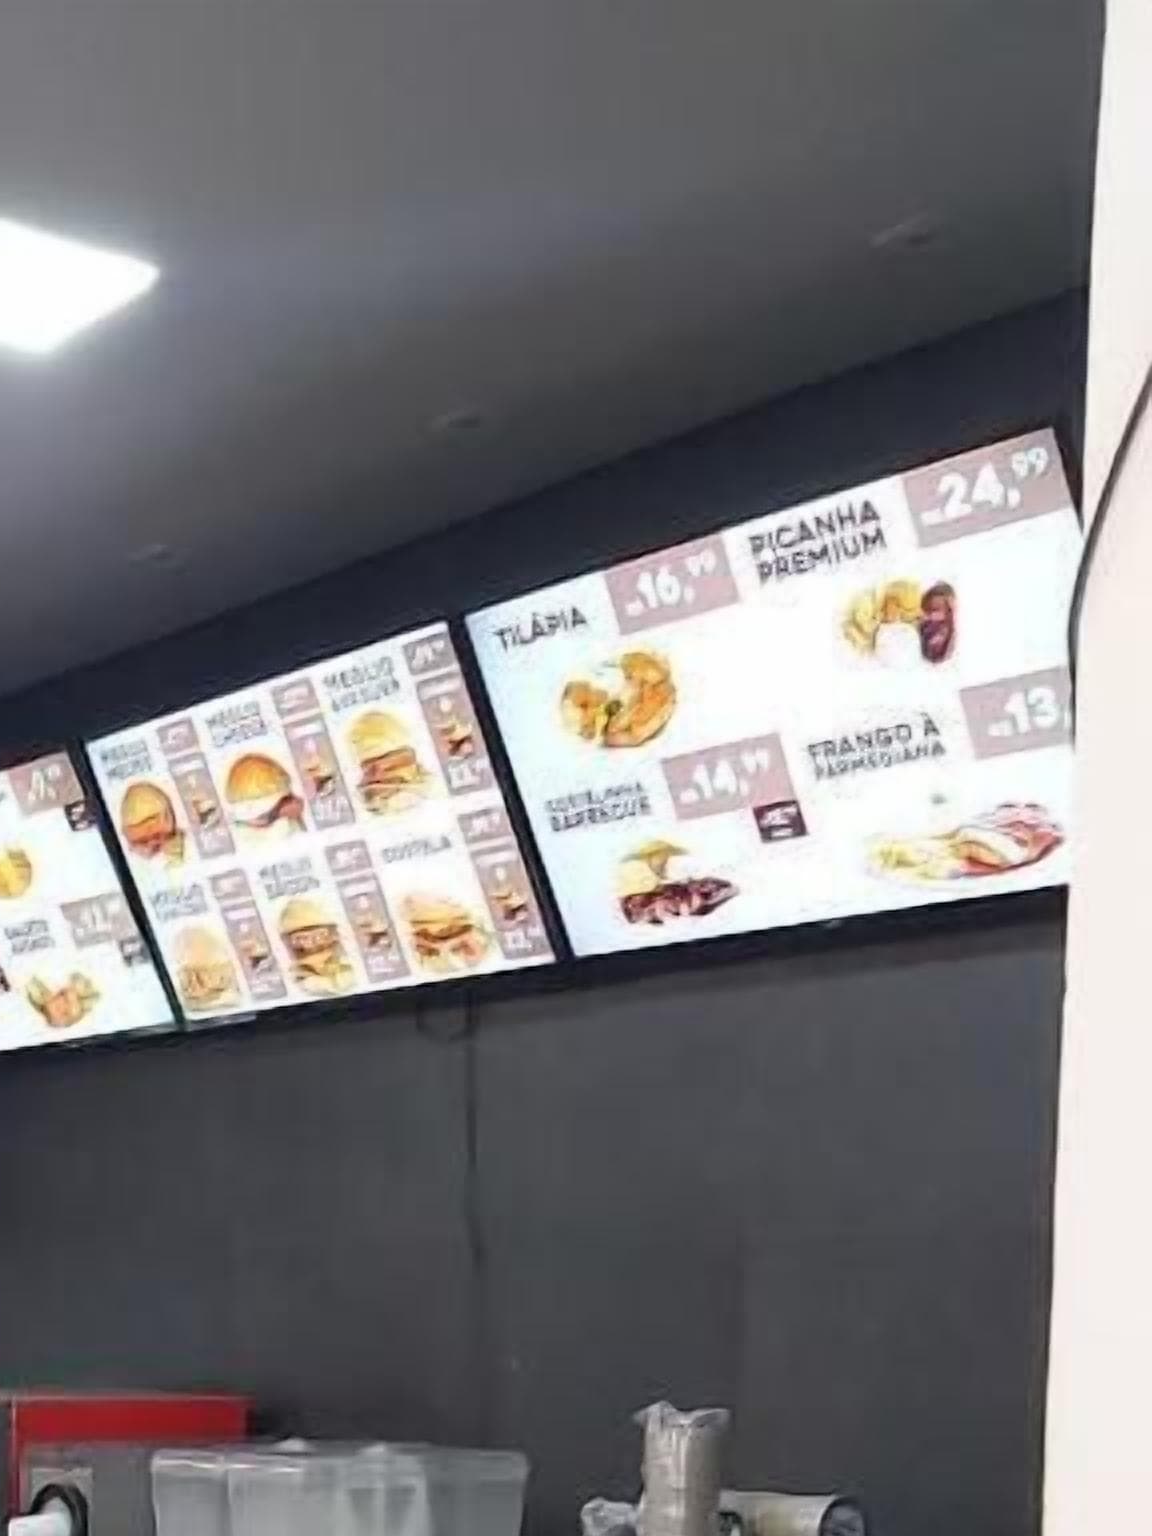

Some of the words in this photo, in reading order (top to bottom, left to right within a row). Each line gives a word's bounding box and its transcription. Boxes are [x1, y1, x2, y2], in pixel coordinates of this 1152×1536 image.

[748, 500, 881, 553] PICANHA
[757, 527, 887, 587] PREMIUM
[807, 723, 912, 763] FRANGO
